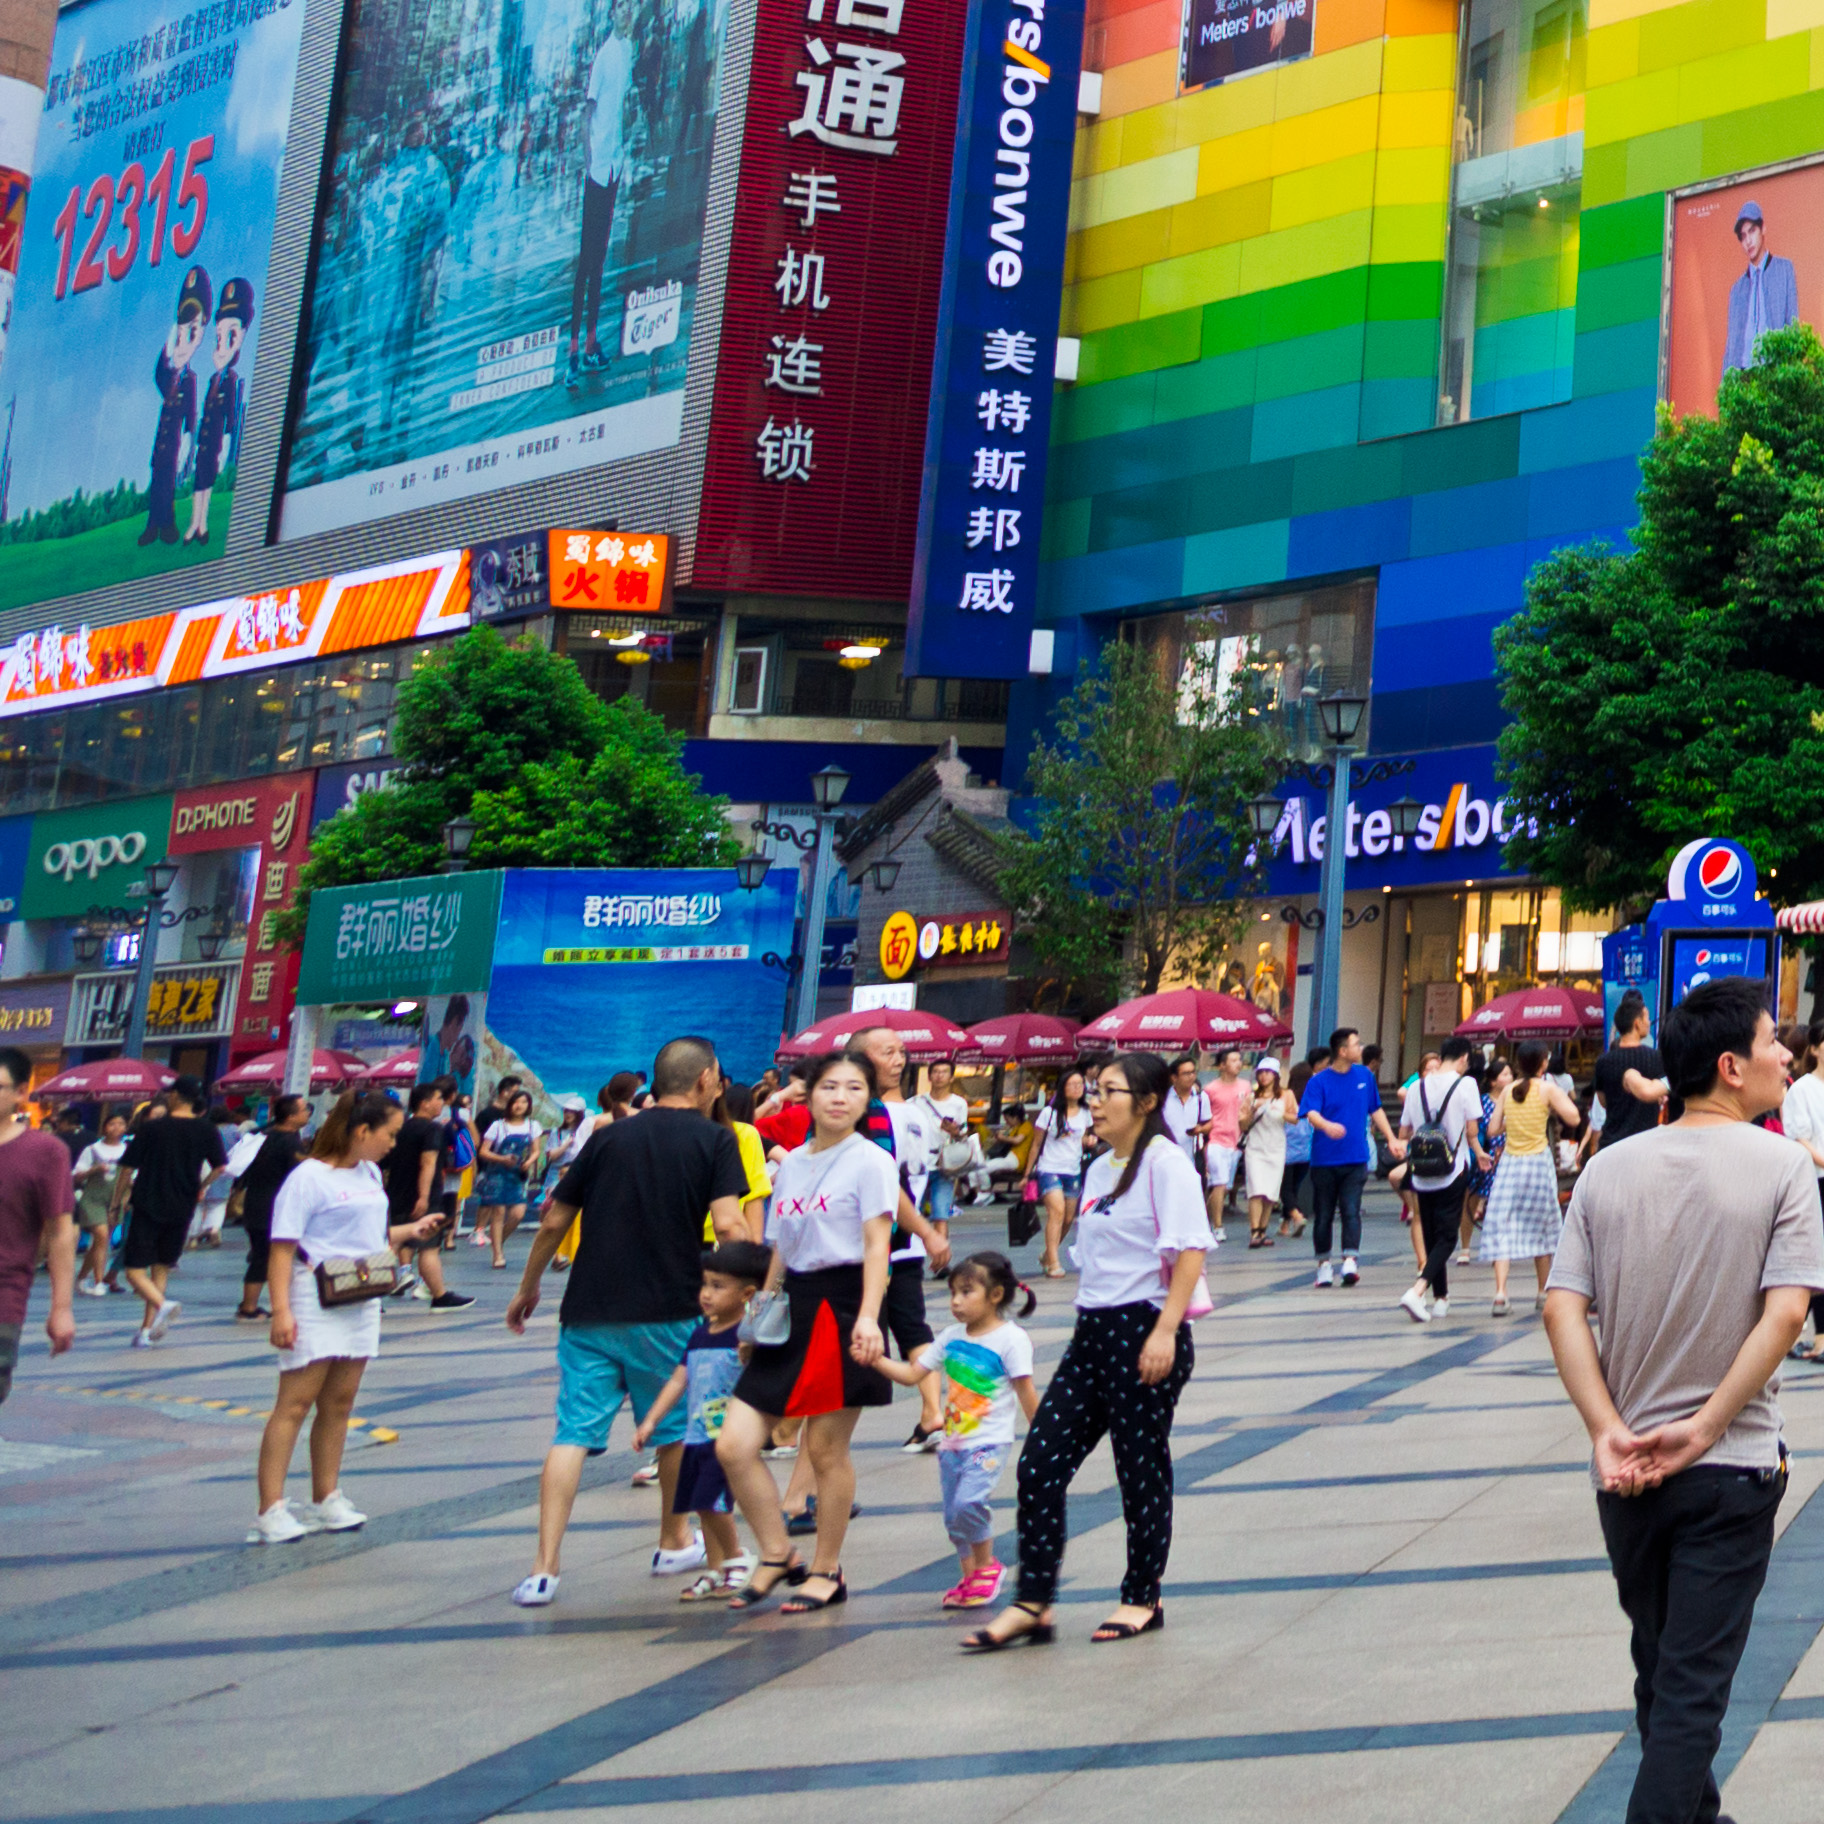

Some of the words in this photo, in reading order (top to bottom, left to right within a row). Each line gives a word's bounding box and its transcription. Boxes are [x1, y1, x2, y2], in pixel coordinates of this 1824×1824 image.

[54, 135, 215, 301] 12315
[626, 279, 683, 310] Onitsuka
[756, 169, 842, 482] 手机连锁
[959, 328, 1037, 614] 美特斯邦威
[583, 895, 722, 927] 群丽婚纱
